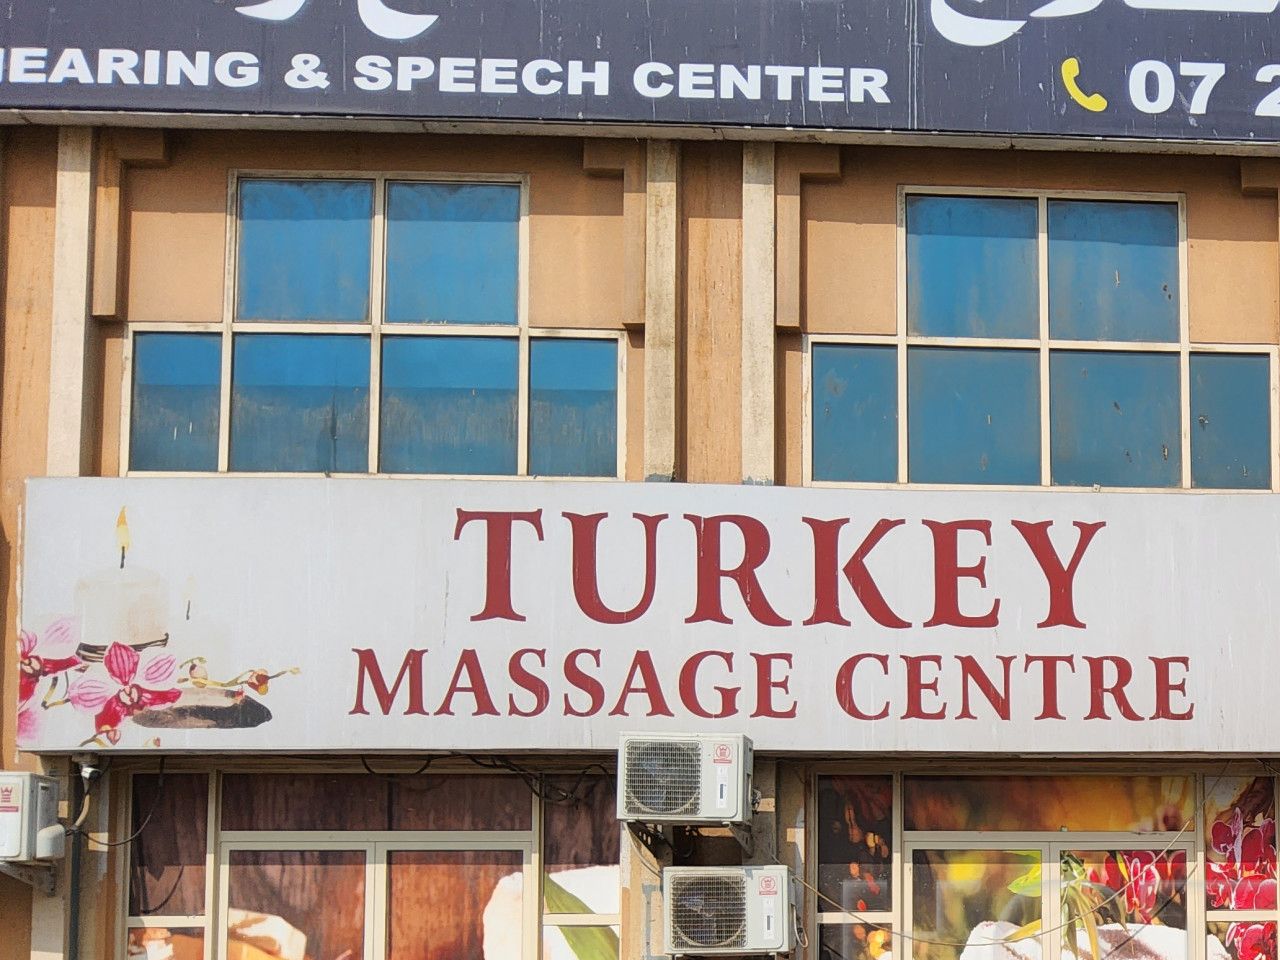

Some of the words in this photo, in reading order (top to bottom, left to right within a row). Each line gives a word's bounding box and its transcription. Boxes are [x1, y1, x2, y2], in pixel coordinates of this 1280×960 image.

[0, 47, 260, 88] EARING
[284, 53, 331, 89] &
[353, 54, 610, 96] SPEECH
[633, 60, 891, 104] CENTER
[1128, 59, 1226, 115] 07
[454, 507, 1106, 629] TURKEY
[350, 648, 798, 719] MASSAGE
[835, 652, 1195, 721] CENTRE
